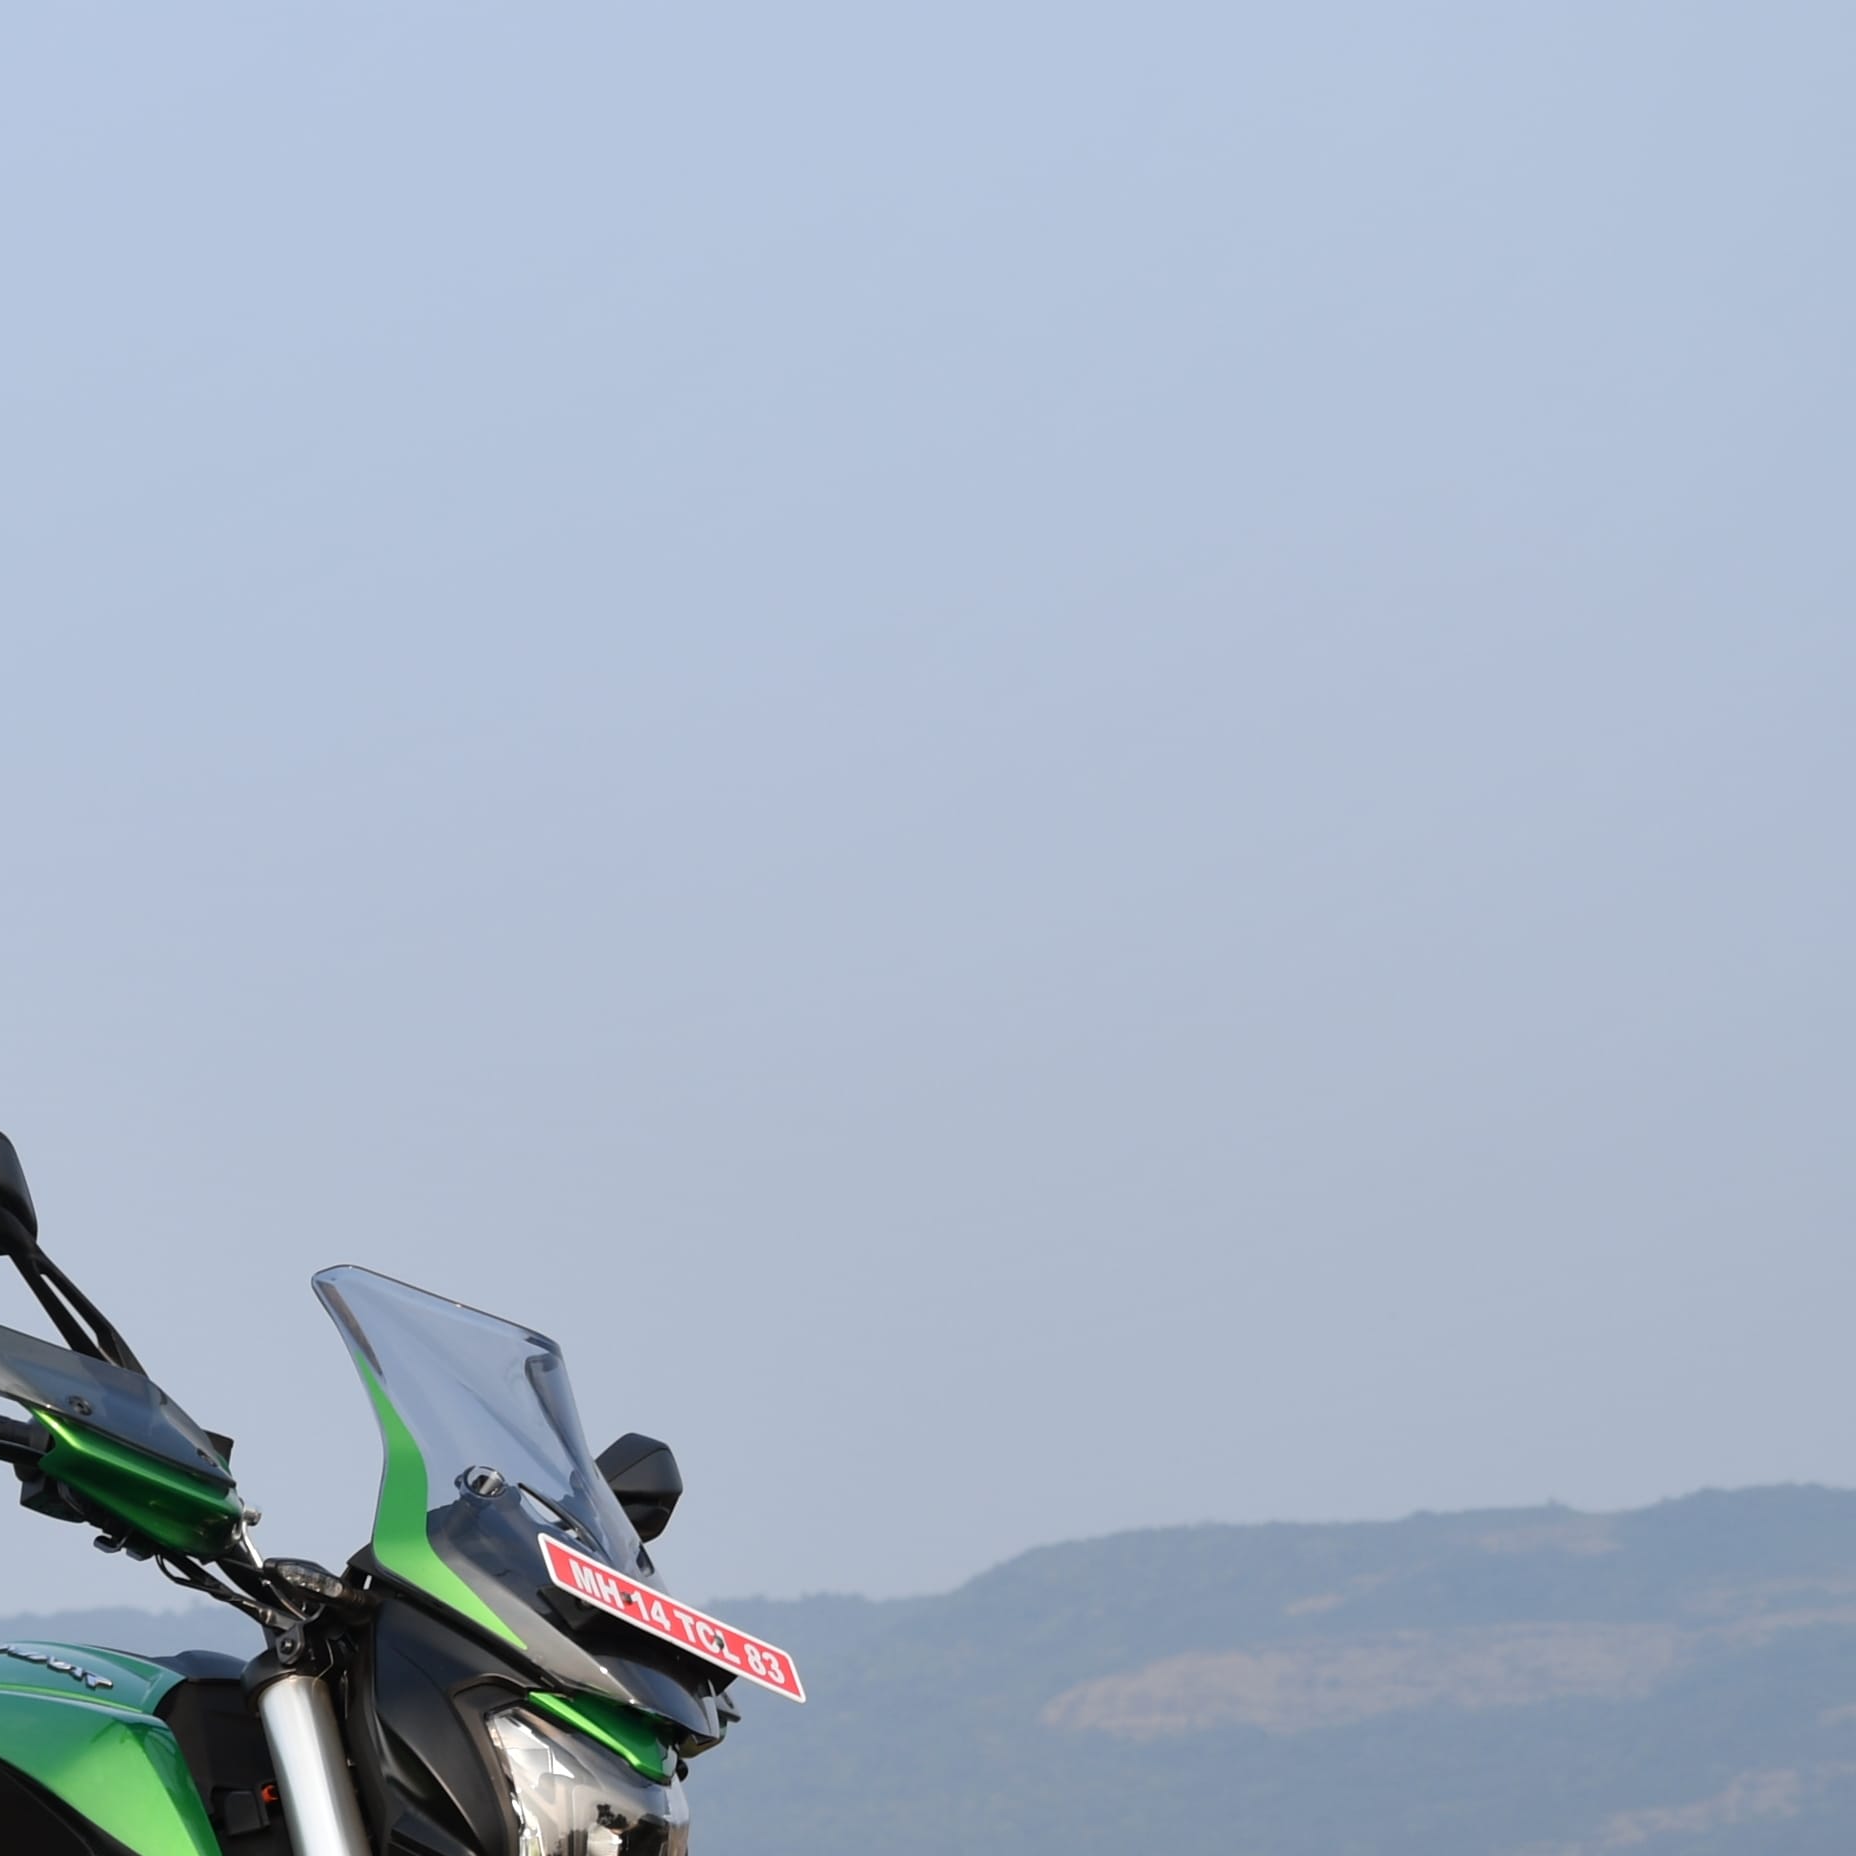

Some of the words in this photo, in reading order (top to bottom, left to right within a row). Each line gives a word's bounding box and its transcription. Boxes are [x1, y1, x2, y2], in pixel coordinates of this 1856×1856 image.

[568, 1558, 625, 1610] MH
[630, 1590, 672, 1632] 14
[672, 1608, 742, 1665] TCL
[743, 1642, 786, 1685] 83
